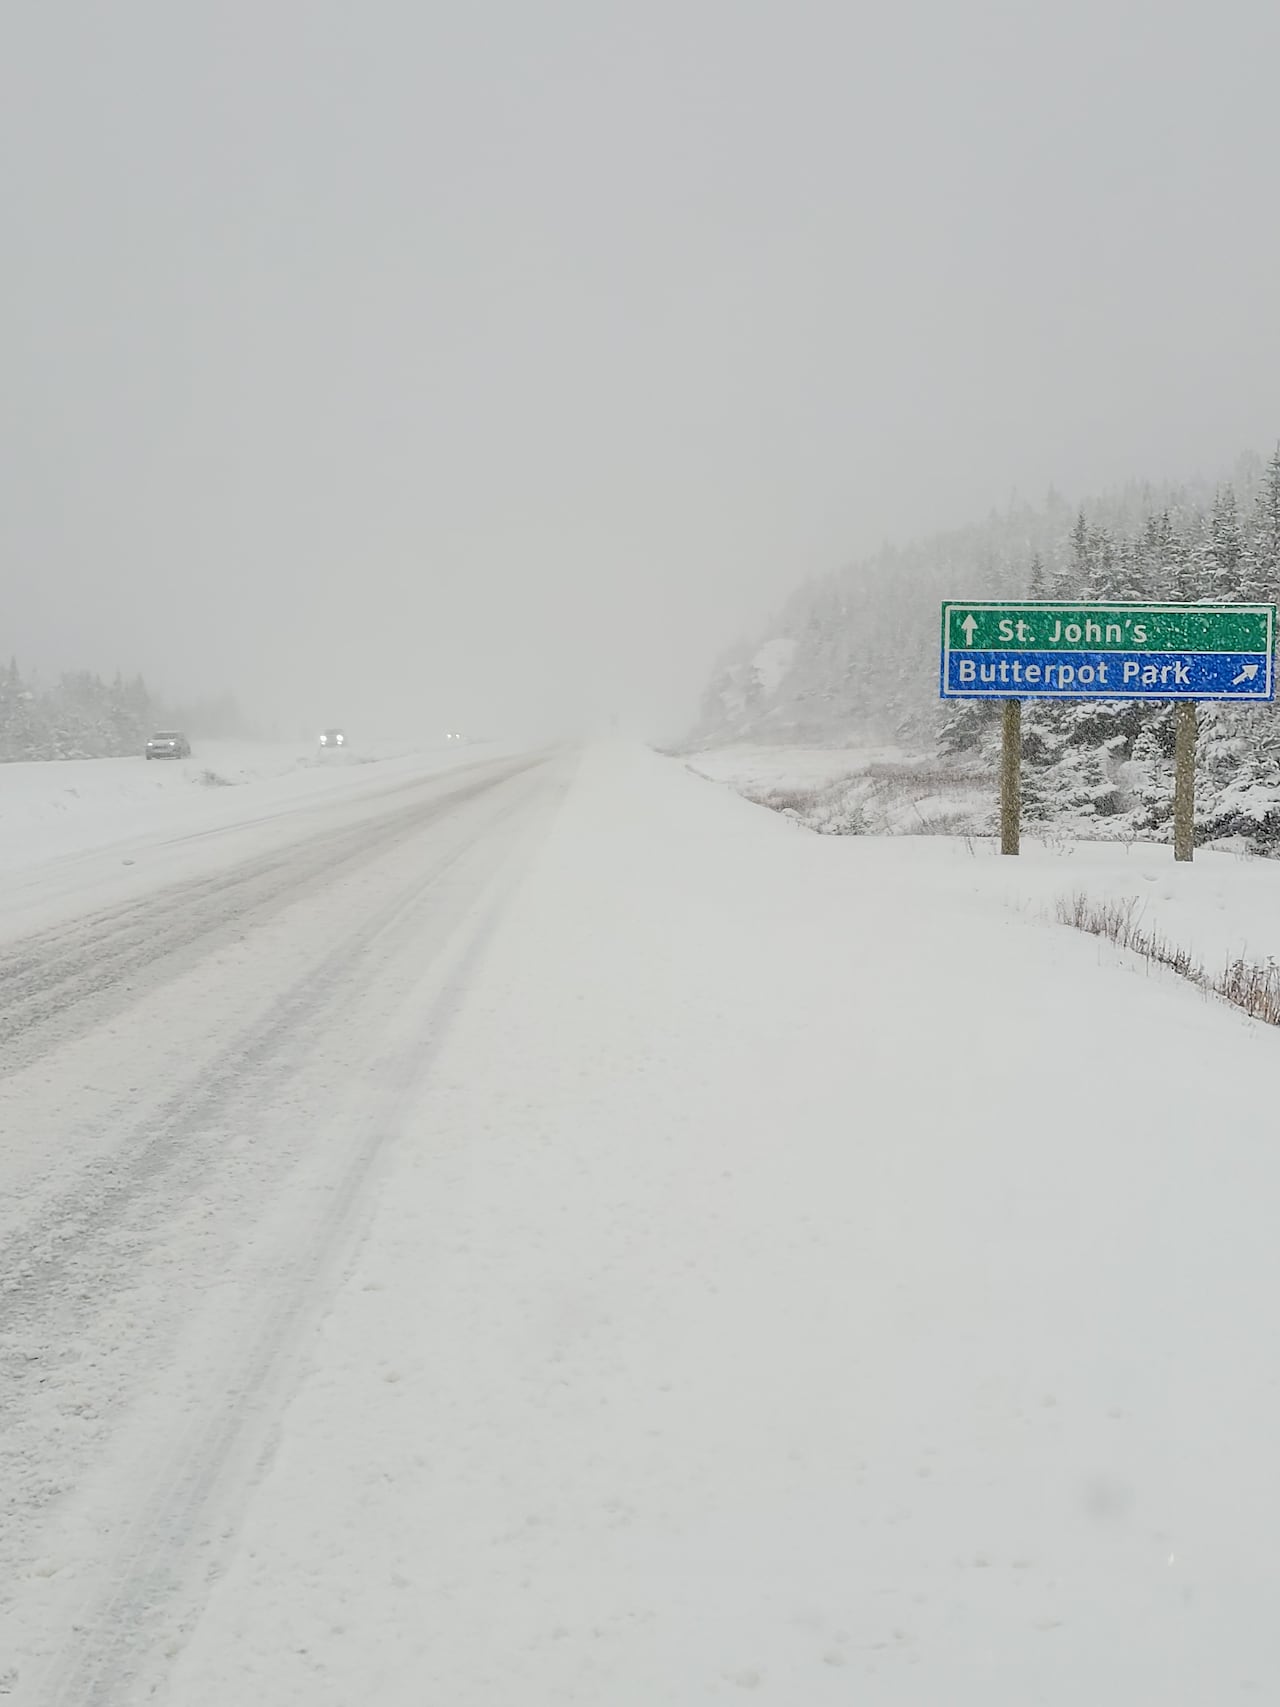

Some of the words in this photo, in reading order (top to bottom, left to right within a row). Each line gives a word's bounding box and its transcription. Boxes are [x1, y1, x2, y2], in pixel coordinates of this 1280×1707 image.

[998, 619, 1035, 642] St.
[1048, 619, 1147, 643] John's
[959, 659, 1108, 688] Butterpot
[1123, 661, 1191, 684] Park
